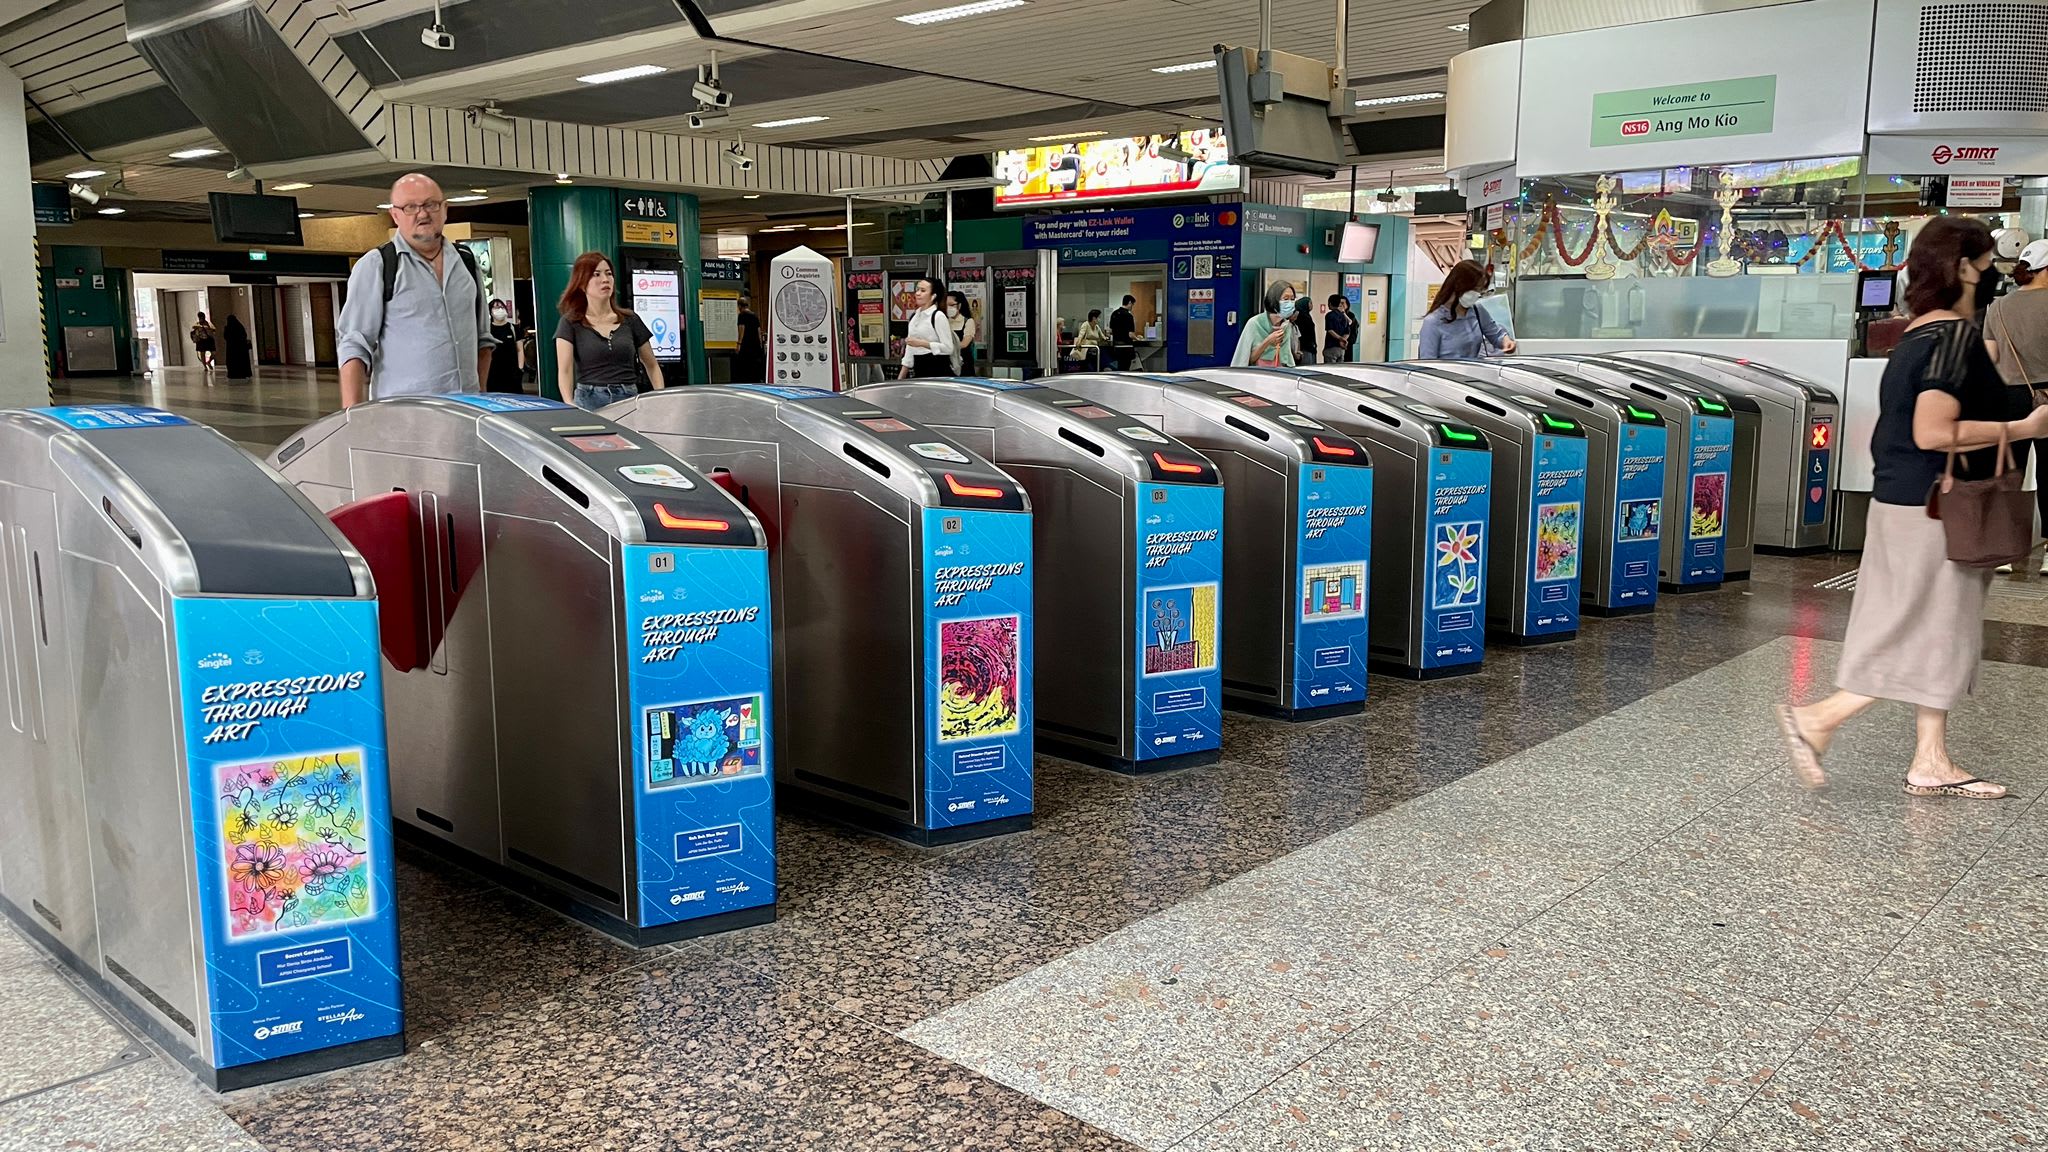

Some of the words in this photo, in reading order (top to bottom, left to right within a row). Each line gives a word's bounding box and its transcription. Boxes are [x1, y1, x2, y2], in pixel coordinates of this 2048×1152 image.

[1653, 93, 1697, 106] Welcome
[1700, 92, 1711, 101] to
[1624, 123, 1648, 133] NS16
[1655, 120, 1683, 133] Ang
[1688, 117, 1710, 130] Mo
[1715, 114, 1738, 127] Kio
[1953, 147, 1999, 159] SMRT
[1034, 222, 1046, 230] Tap
[1047, 221, 1058, 229] and
[1074, 219, 1087, 227] with
[1088, 218, 1113, 227] EZ-Link
[1114, 216, 1134, 225] Wallet
[1034, 231, 1047, 239] with
[1085, 230, 1094, 238] for
[1096, 231, 1109, 239] your
[1111, 228, 1129, 236] rides!
[1683, 226, 1691, 235] B
[1074, 250, 1097, 258] Ticketing
[1098, 248, 1117, 257] Service
[1119, 247, 1136, 256] Centre
[1538, 469, 1584, 480] EXPRESSIONS
[1537, 479, 1568, 488] THROUGH
[1154, 491, 1164, 500] 03
[1434, 484, 1487, 497] EXPRESSIONS
[1537, 488, 1553, 497] ART
[1434, 495, 1468, 506] THROUGH
[1306, 505, 1368, 518] EXPRESSIONS
[1434, 506, 1452, 516] ART
[946, 520, 957, 530] 02
[1306, 517, 1345, 528] THROUGH
[1146, 528, 1218, 545] EXPRESSIONS
[1305, 528, 1327, 539] ART
[1146, 542, 1193, 556] THROUGH
[655, 557, 668, 568] 01
[1145, 555, 1171, 568] ART
[934, 562, 1025, 580] EXPRESSIONS
[934, 577, 993, 593] THROUGH
[934, 592, 966, 607] ART
[641, 606, 759, 632] EXPRESSIONS
[641, 626, 719, 647] THROUGH
[642, 645, 683, 664] ART
[201, 671, 366, 704] EXPRESSIONS
[201, 696, 309, 724] THROUGH
[202, 721, 261, 745] ART
[733, 881, 750, 895] Ace
[285, 951, 303, 960] Secret
[303, 948, 324, 957] Garden
[317, 1012, 346, 1022] STELLAR
[341, 1008, 365, 1025] Ace
[270, 1021, 304, 1036] SMRT
